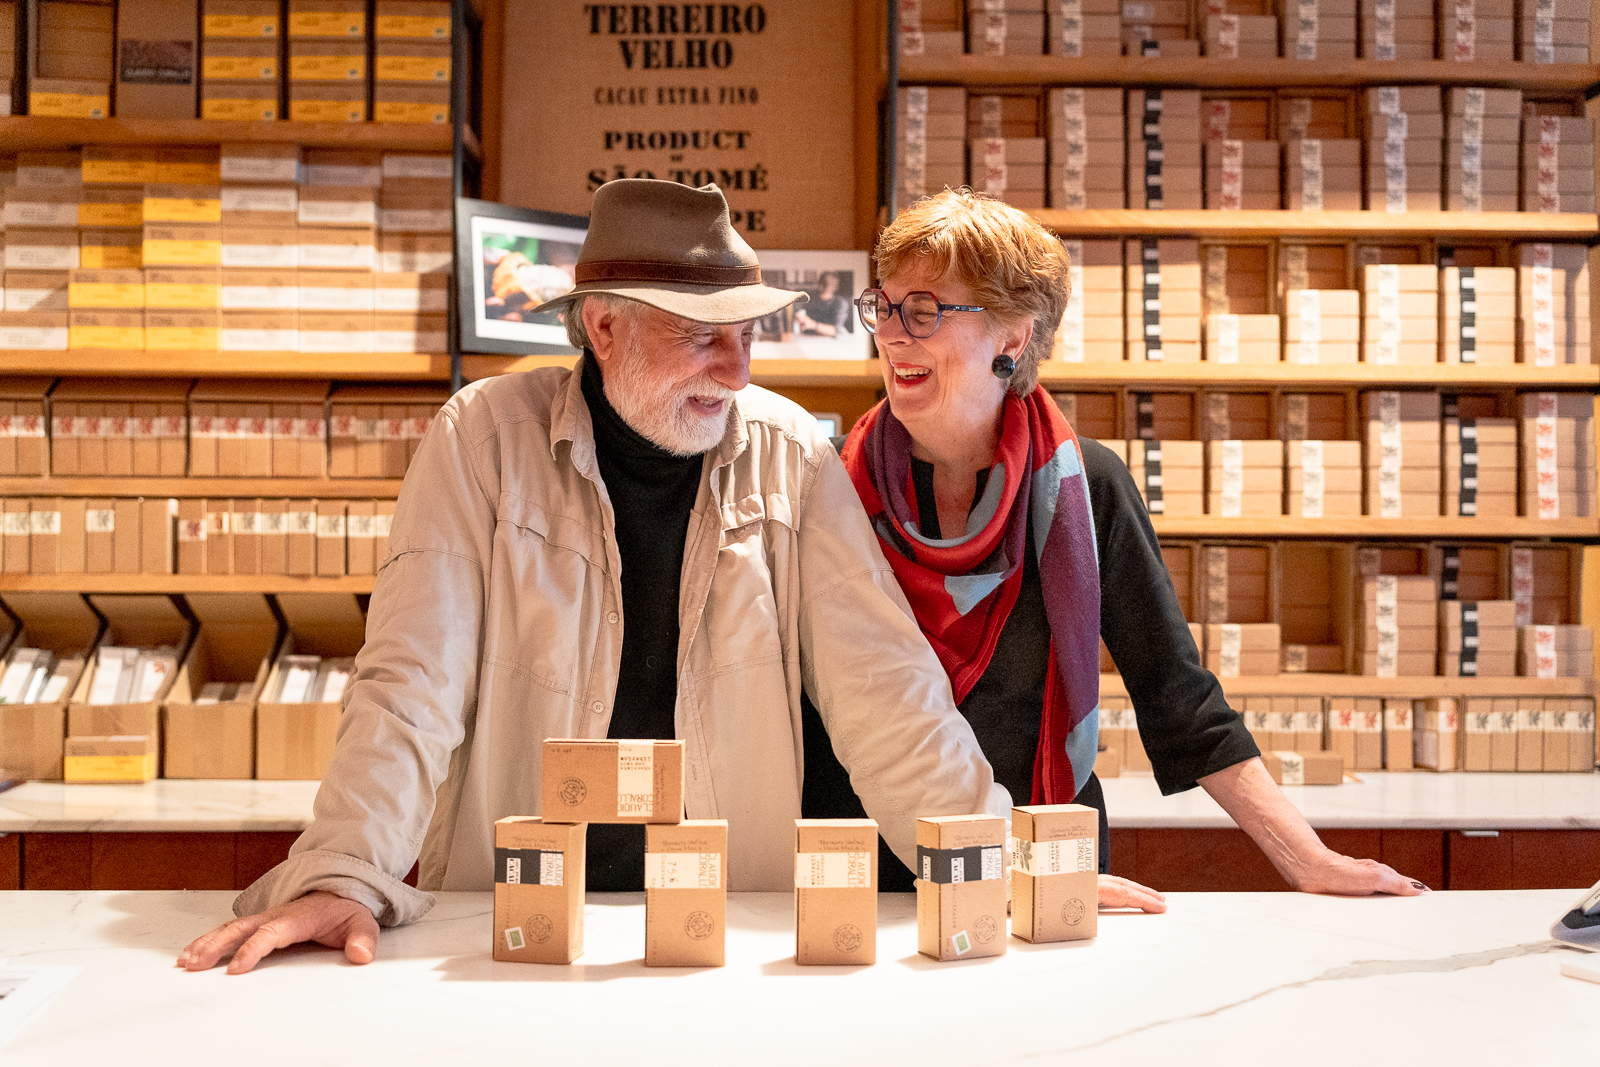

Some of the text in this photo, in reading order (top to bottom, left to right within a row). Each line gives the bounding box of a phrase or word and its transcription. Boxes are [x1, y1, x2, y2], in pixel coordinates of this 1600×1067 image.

[584, 4, 766, 34] TERREIRO
[619, 39, 733, 69] VELHO
[656, 86, 710, 105] EXTRA
[719, 86, 759, 105] FINO
[604, 129, 752, 151] PRODUCT
[669, 164, 768, 191] TOMÉ
[546, 853, 554, 885] CORALL
[555, 853, 563, 886] CLAUDI
[986, 848, 994, 880] CORALL
[994, 848, 1002, 879] CLAUDI
[1076, 838, 1085, 873] CORALLO
[1084, 837, 1093, 872] CLAUDIO
